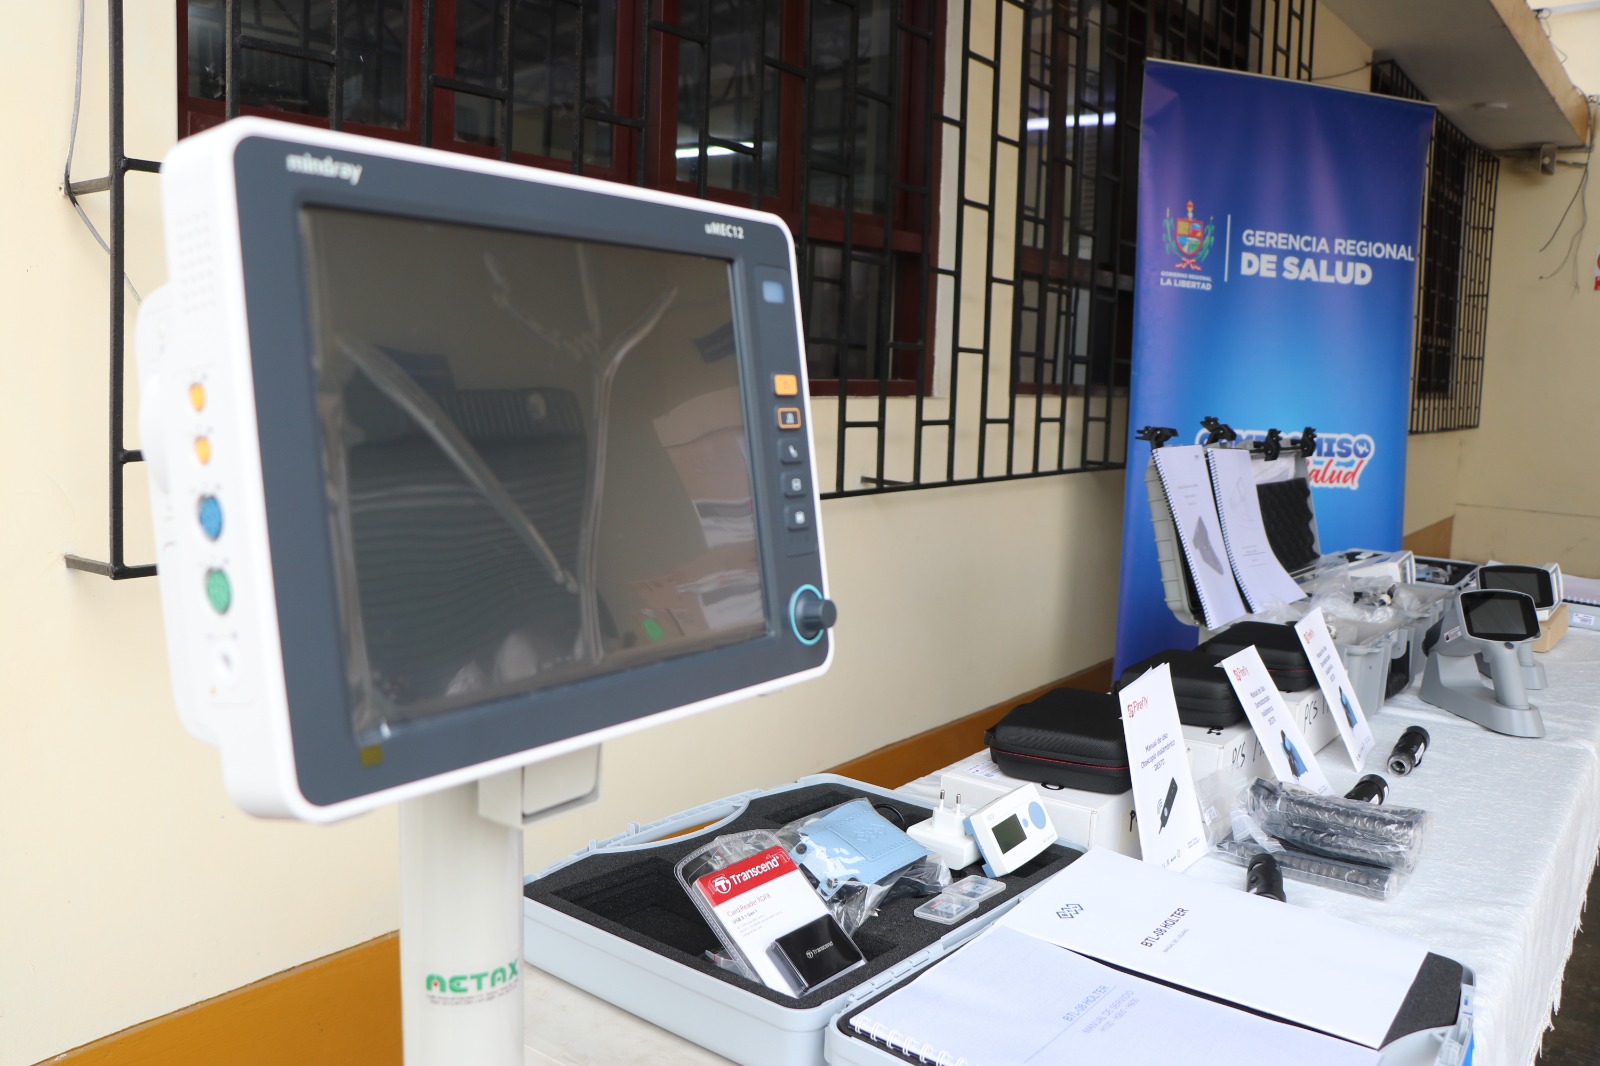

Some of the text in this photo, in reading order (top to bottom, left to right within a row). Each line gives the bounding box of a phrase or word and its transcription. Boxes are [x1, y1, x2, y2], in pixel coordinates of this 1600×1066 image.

[286, 152, 363, 185] mindray
[1242, 229, 1415, 261] GERENCIA REGIONAL
[1160, 278, 1212, 291] LA LIBERTAD
[1240, 252, 1372, 286] DE SALUD
[730, 857, 779, 885] Transcend
[727, 906, 740, 917] Card
[740, 900, 757, 911] Reader
[1140, 907, 1189, 947] BTL-08 HOLTER
[812, 941, 833, 955] Transcend
[1062, 985, 1109, 1022] BTL-08 HOLTER
